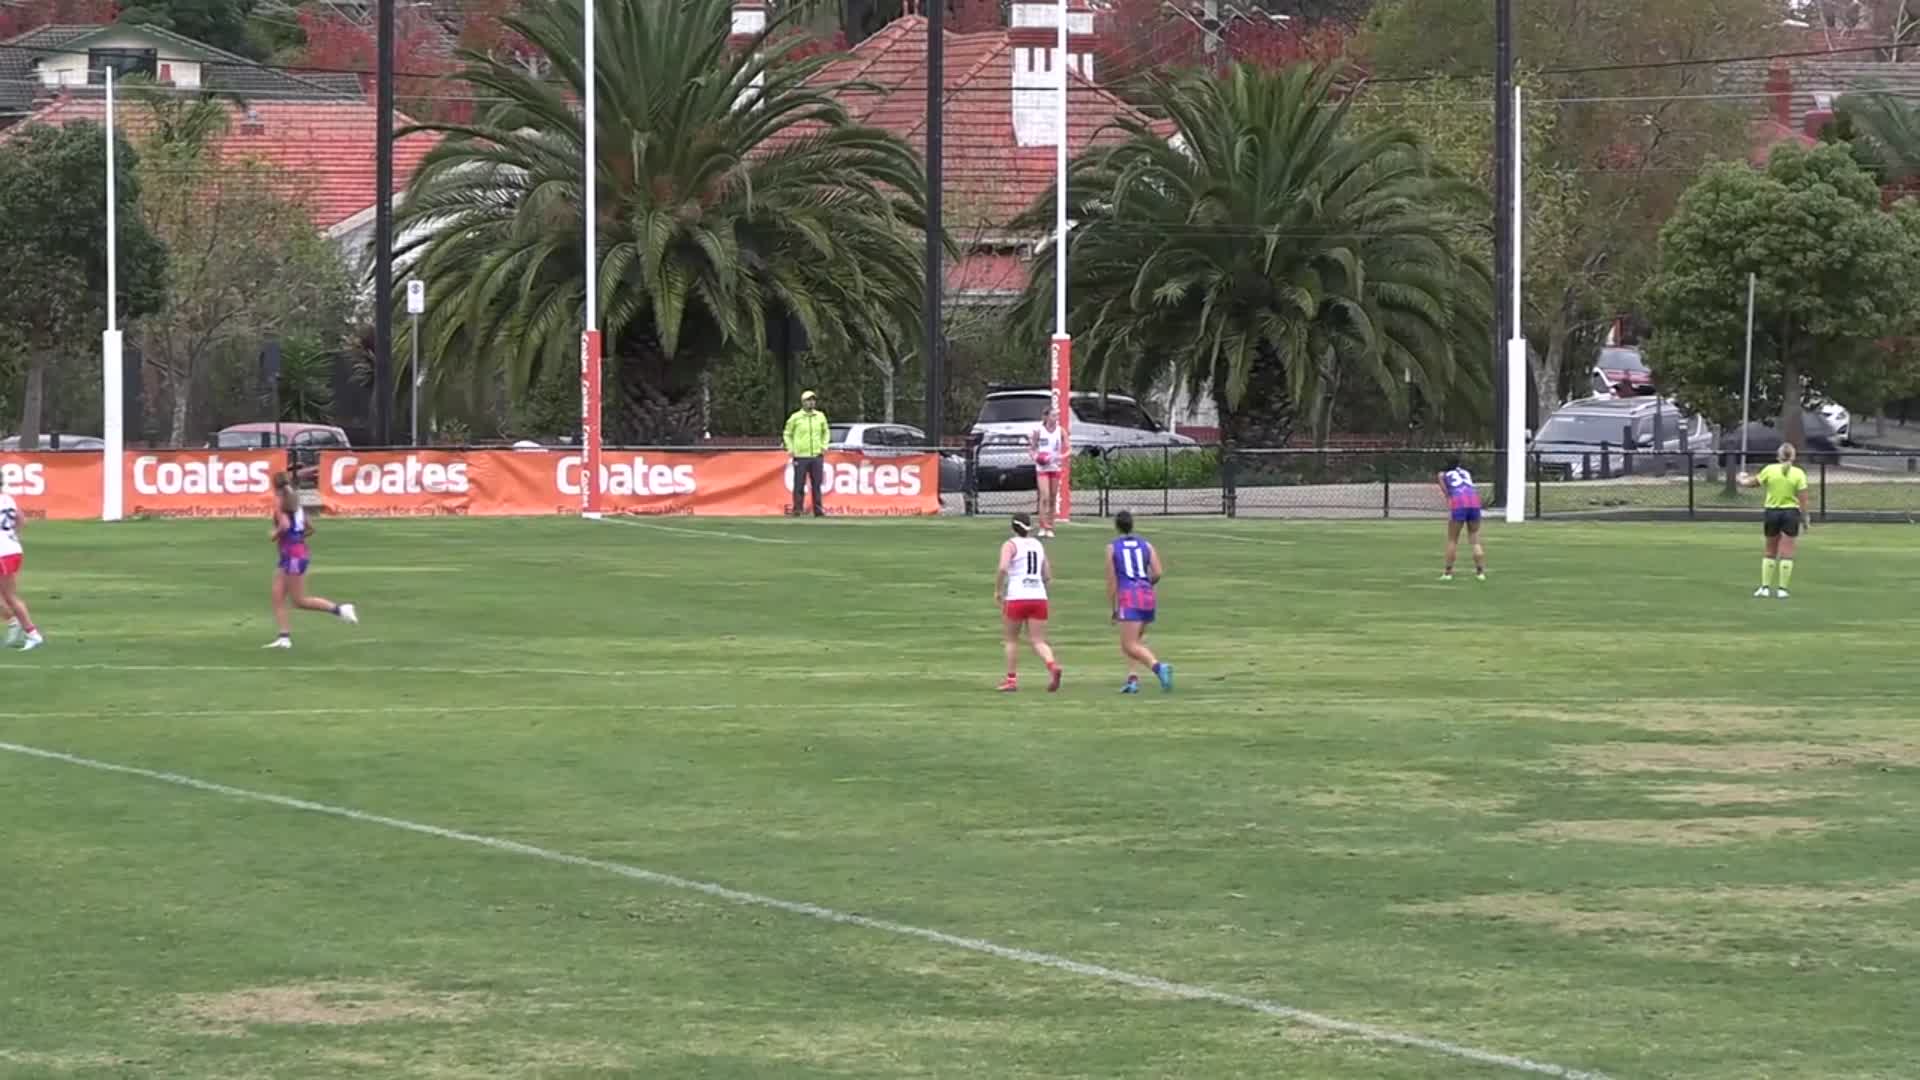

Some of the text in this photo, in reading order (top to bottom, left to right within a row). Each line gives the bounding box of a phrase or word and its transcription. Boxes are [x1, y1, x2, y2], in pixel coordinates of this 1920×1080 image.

[133, 455, 271, 495] Coates
[331, 455, 471, 495] Coates
[1027, 550, 1038, 575] 11
[1122, 548, 1147, 578] 11
